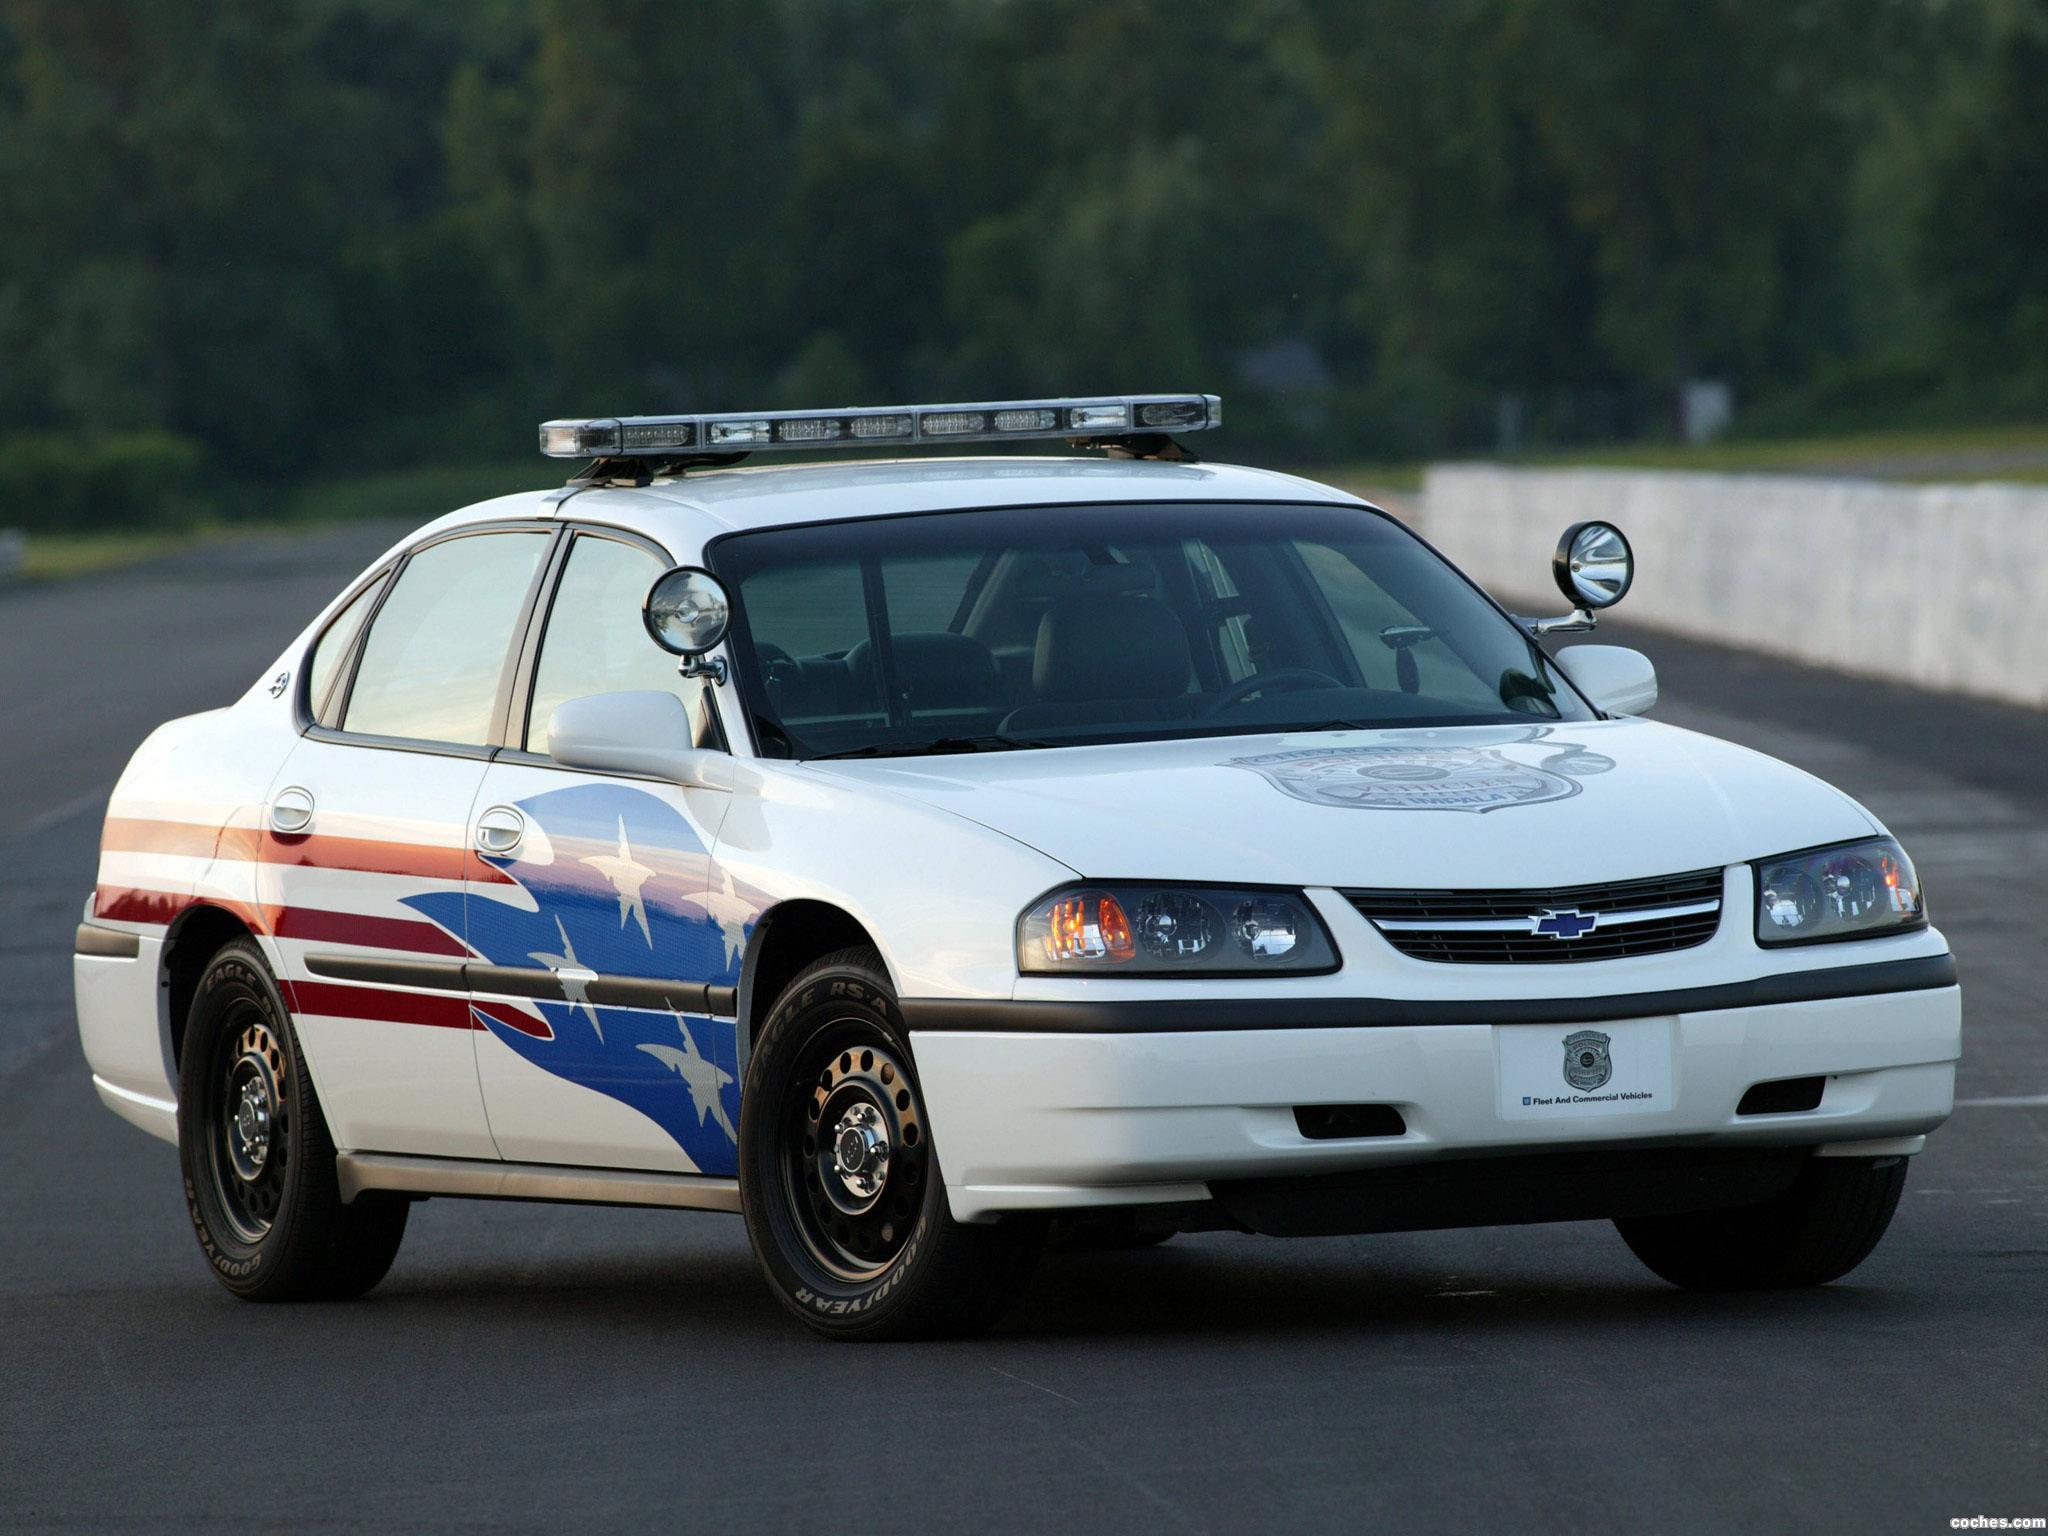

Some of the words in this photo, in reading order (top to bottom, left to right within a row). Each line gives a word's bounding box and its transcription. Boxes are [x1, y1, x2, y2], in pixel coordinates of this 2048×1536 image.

[1407, 793, 1507, 804] IMPALA
[1533, 1097, 1553, 1105] Fleet
[1555, 1096, 1571, 1104] And
[1573, 1093, 1619, 1103] Commercial
[1620, 1092, 1653, 1101] Vehicles
[795, 1216, 928, 1314] GOODYEAR
